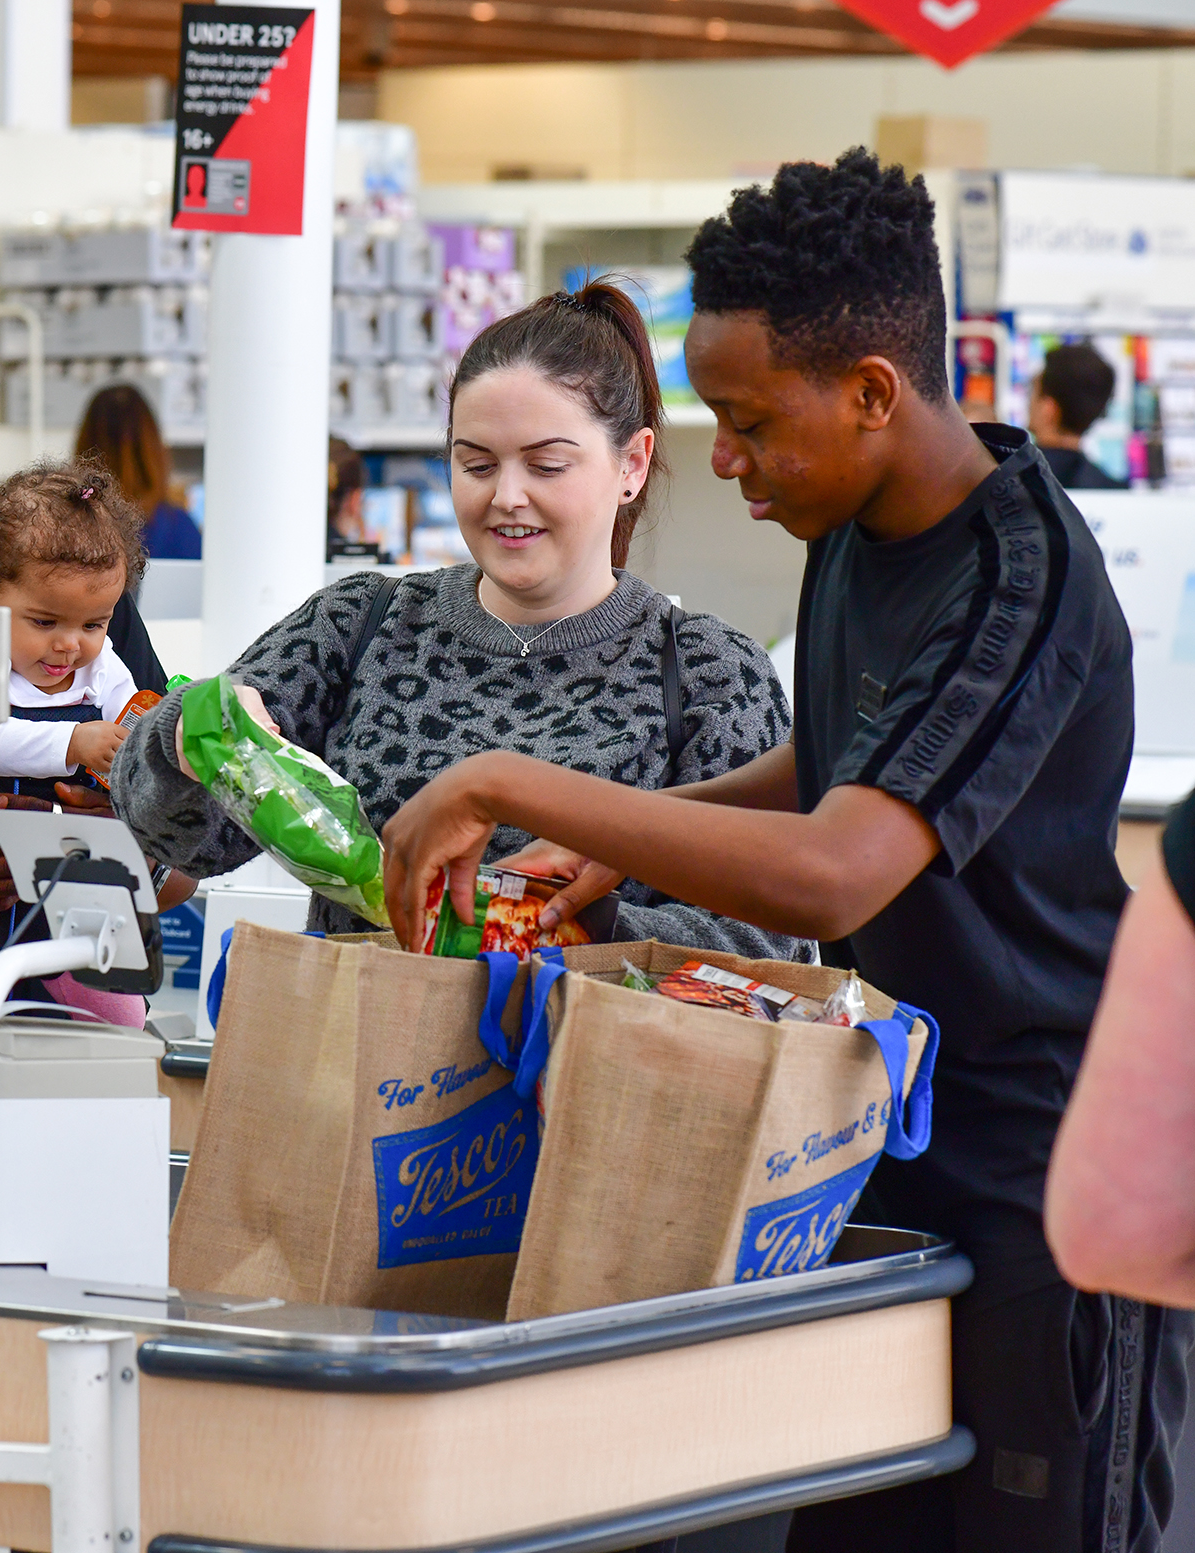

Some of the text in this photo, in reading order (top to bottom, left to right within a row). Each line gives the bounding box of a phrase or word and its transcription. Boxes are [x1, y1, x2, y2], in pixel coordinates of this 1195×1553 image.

[188, 22, 297, 48] UNDER 25?
[186, 50, 288, 70] Please be prepared
[185, 67, 198, 82] to
[199, 68, 225, 83] show
[226, 68, 258, 84] proof
[184, 83, 270, 104] age when buying
[183, 100, 218, 117] energy
[182, 128, 215, 150] 16+
[378, 1078, 424, 1111] For
[766, 1150, 798, 1182] For
[802, 1120, 860, 1166] Flavour
[862, 1102, 877, 1134] &
[391, 1108, 527, 1228] Tesco
[483, 1193, 517, 1219] TEA
